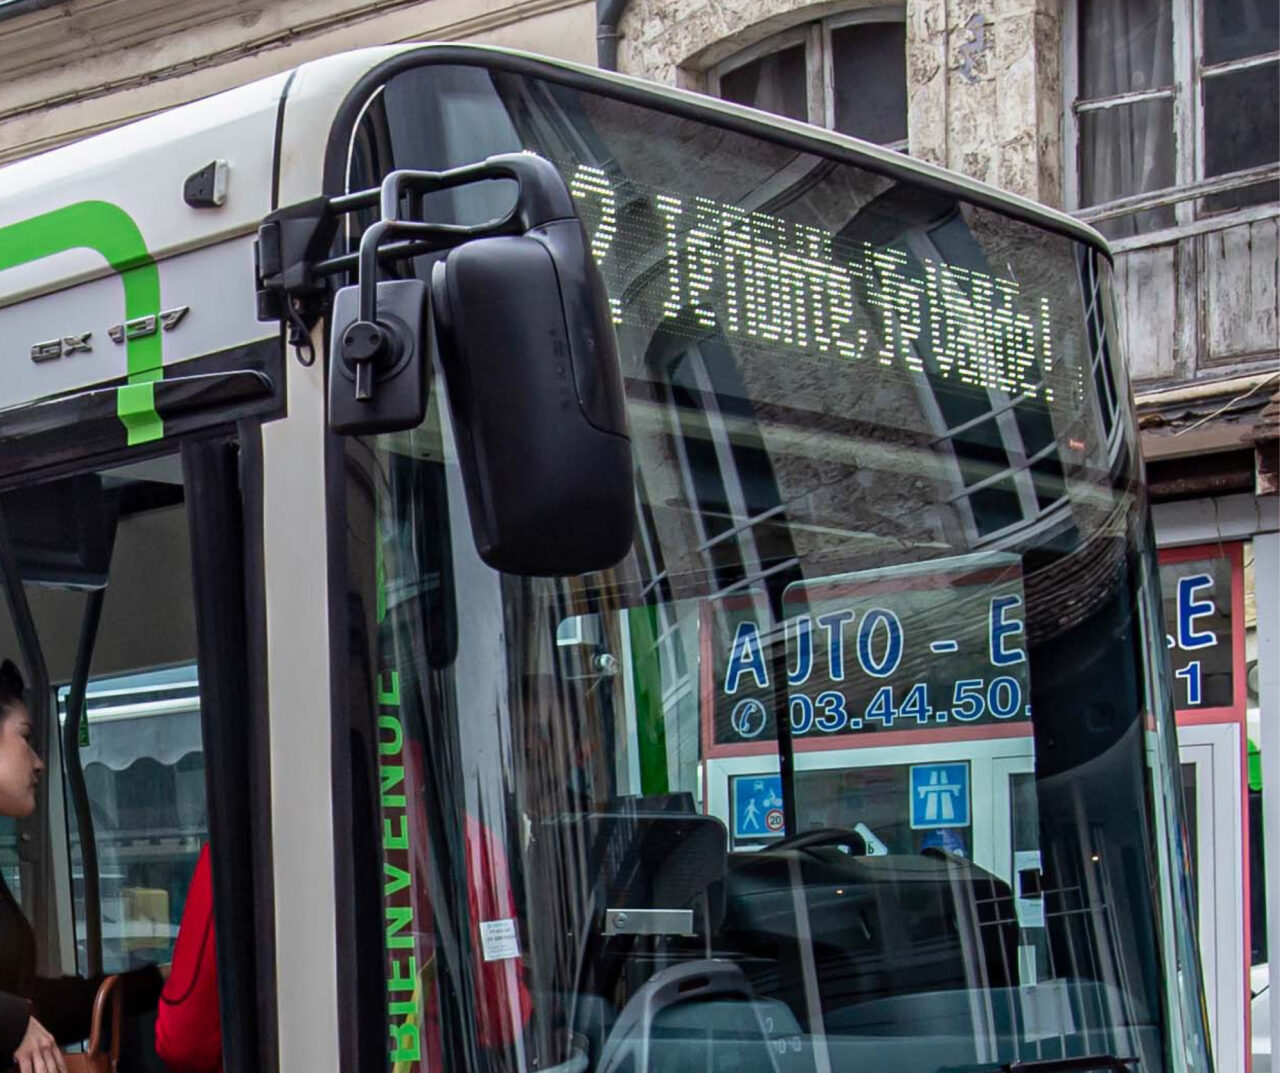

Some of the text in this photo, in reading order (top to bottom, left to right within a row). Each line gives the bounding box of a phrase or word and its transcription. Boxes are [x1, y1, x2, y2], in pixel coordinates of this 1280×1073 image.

[31, 305, 190, 364] GX 137
[724, 607, 905, 694] AUTO
[376, 671, 421, 1062] BIENVENUE
